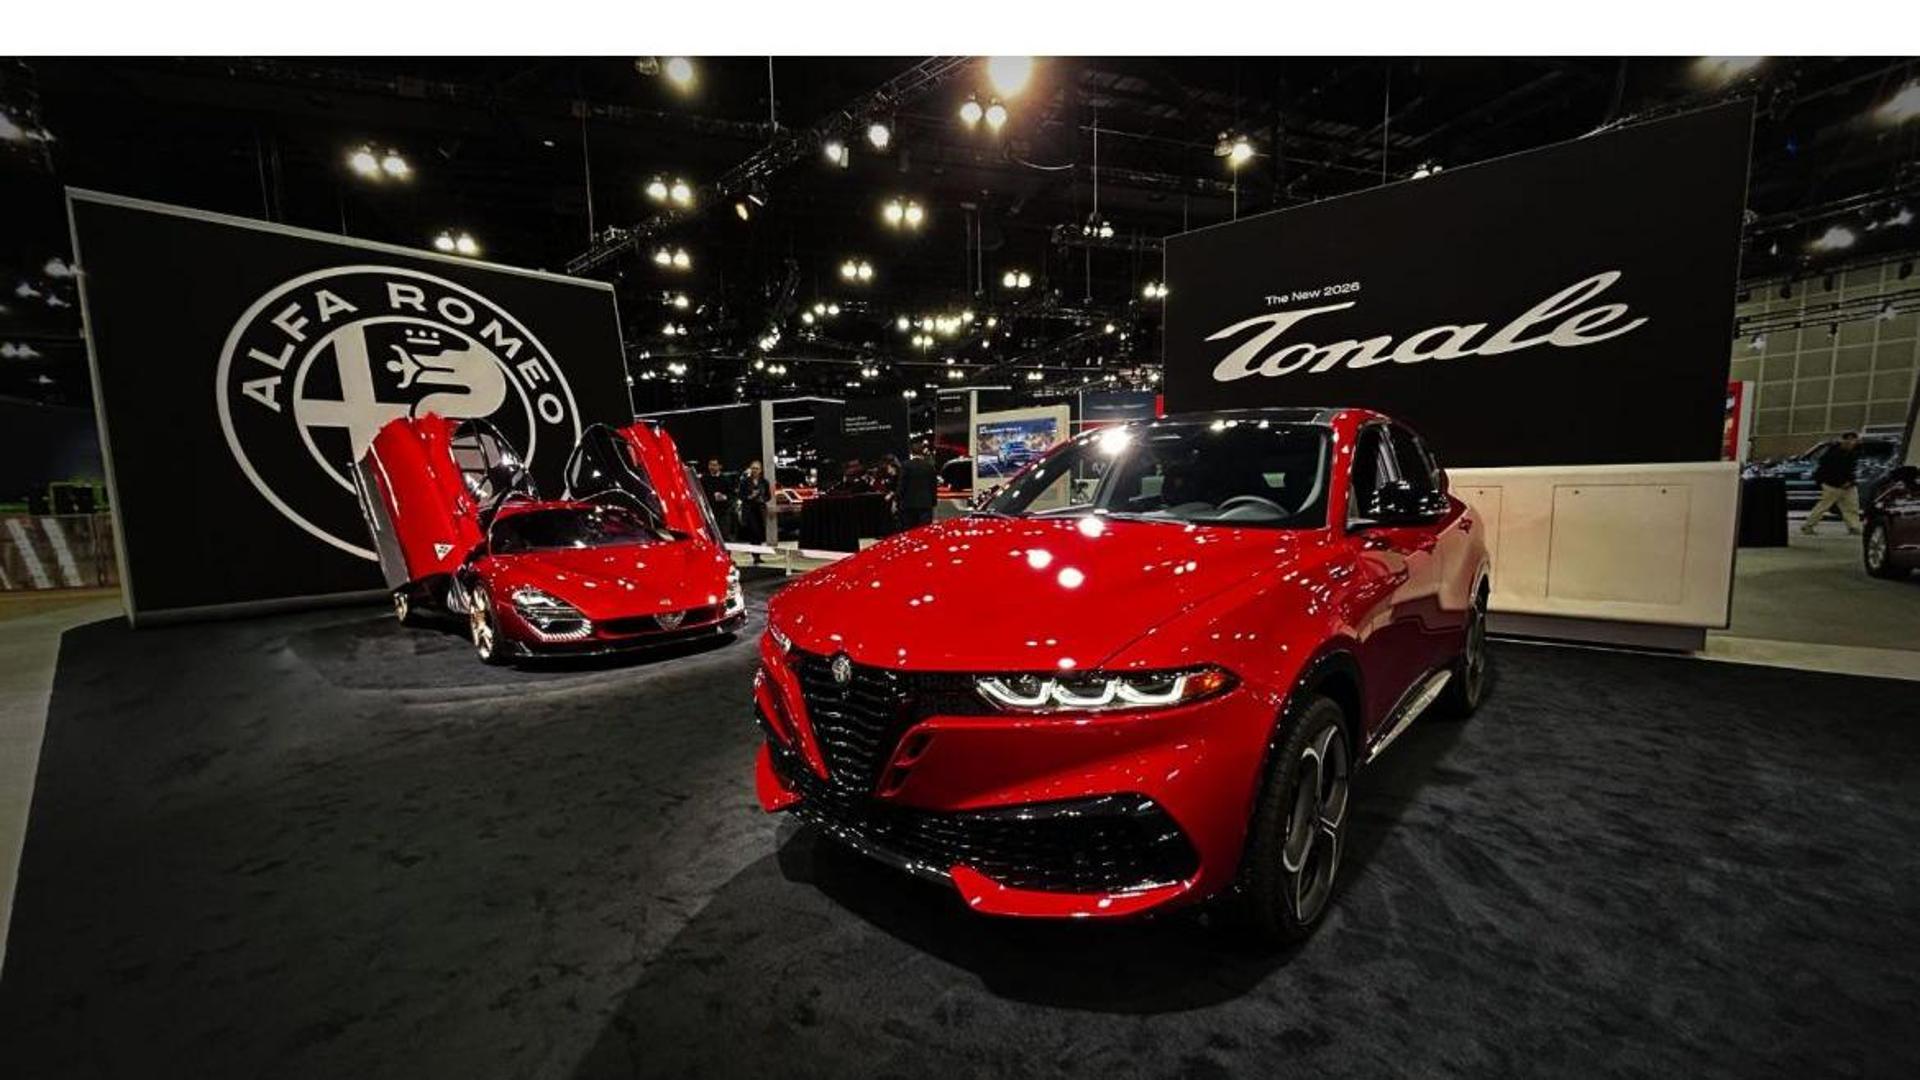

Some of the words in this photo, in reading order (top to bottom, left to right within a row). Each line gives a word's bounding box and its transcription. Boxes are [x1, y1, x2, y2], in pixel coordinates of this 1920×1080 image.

[1203, 270, 1649, 382] Tonale
[1264, 294, 1290, 306] The
[1291, 289, 1321, 302] New
[1323, 281, 1361, 297] 2026
[242, 288, 359, 413] ALFA
[385, 280, 565, 425] ROMEO
